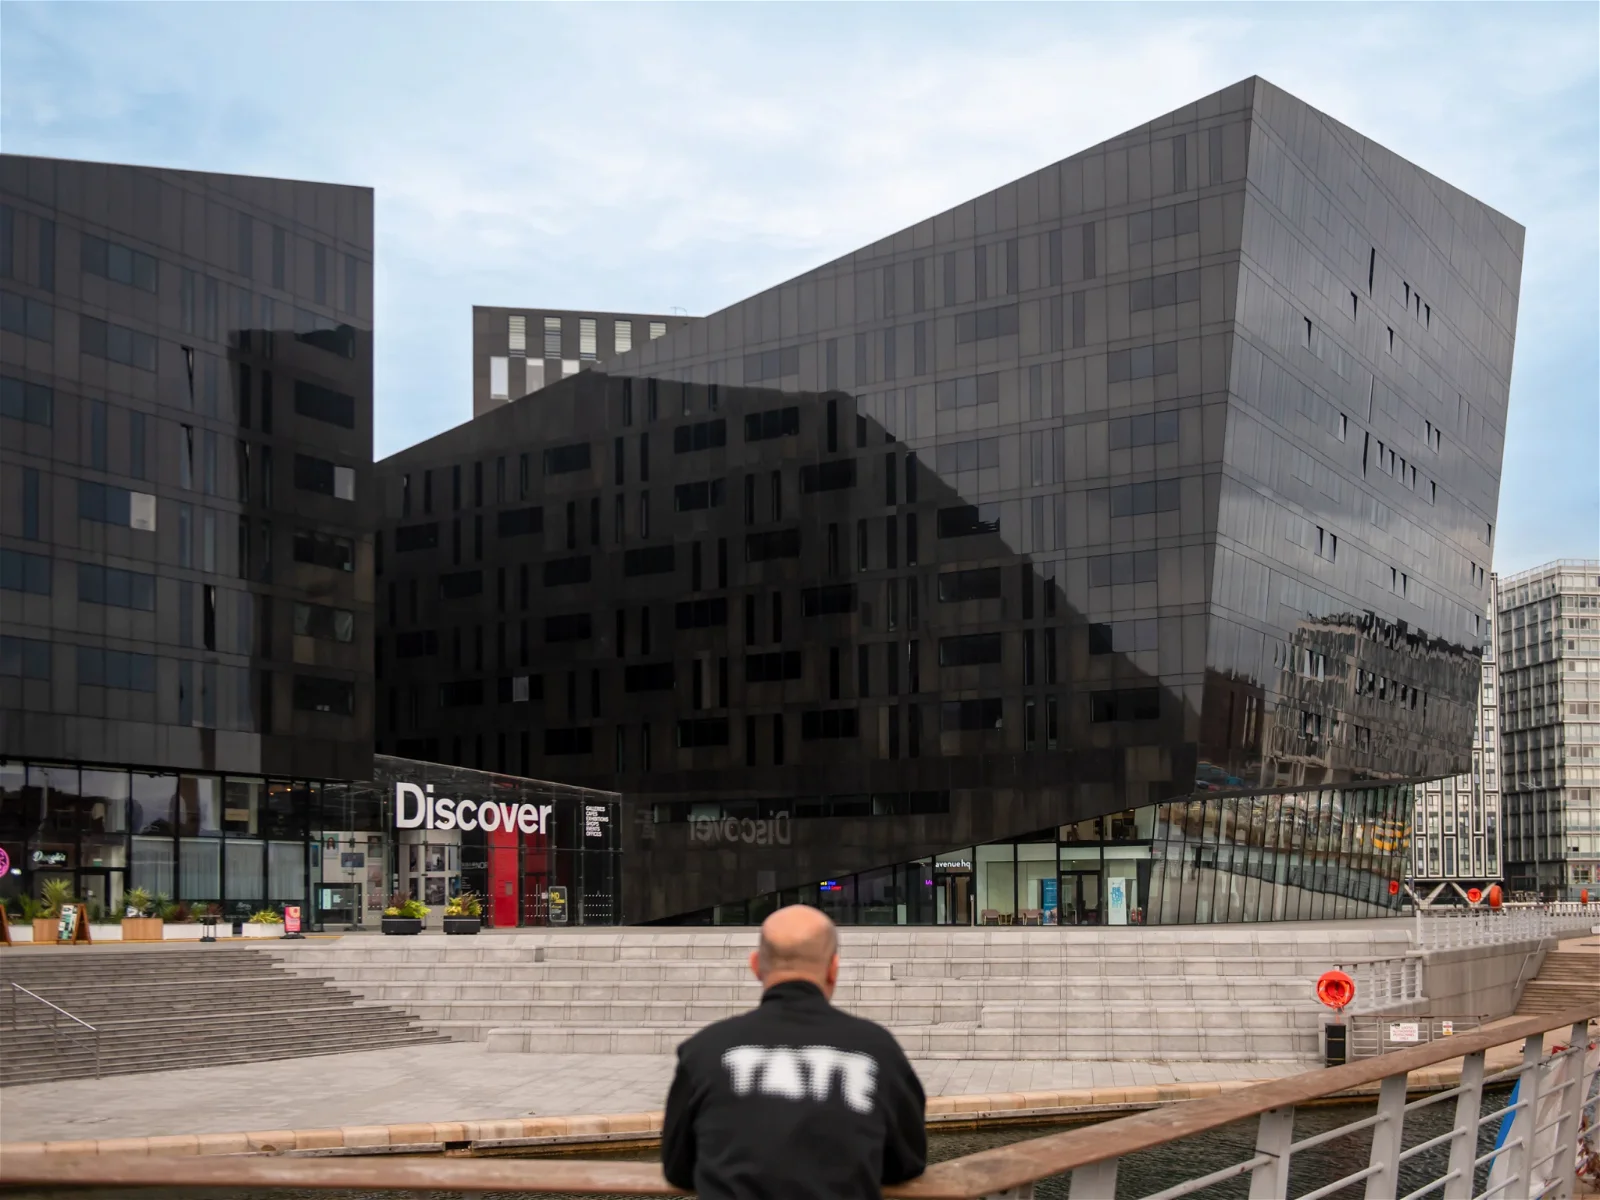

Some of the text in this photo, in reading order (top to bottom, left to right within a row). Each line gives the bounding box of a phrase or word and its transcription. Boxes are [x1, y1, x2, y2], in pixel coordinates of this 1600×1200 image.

[396, 782, 552, 834] Discover
[961, 859, 971, 871] hq
[721, 1045, 878, 1114] TATE
